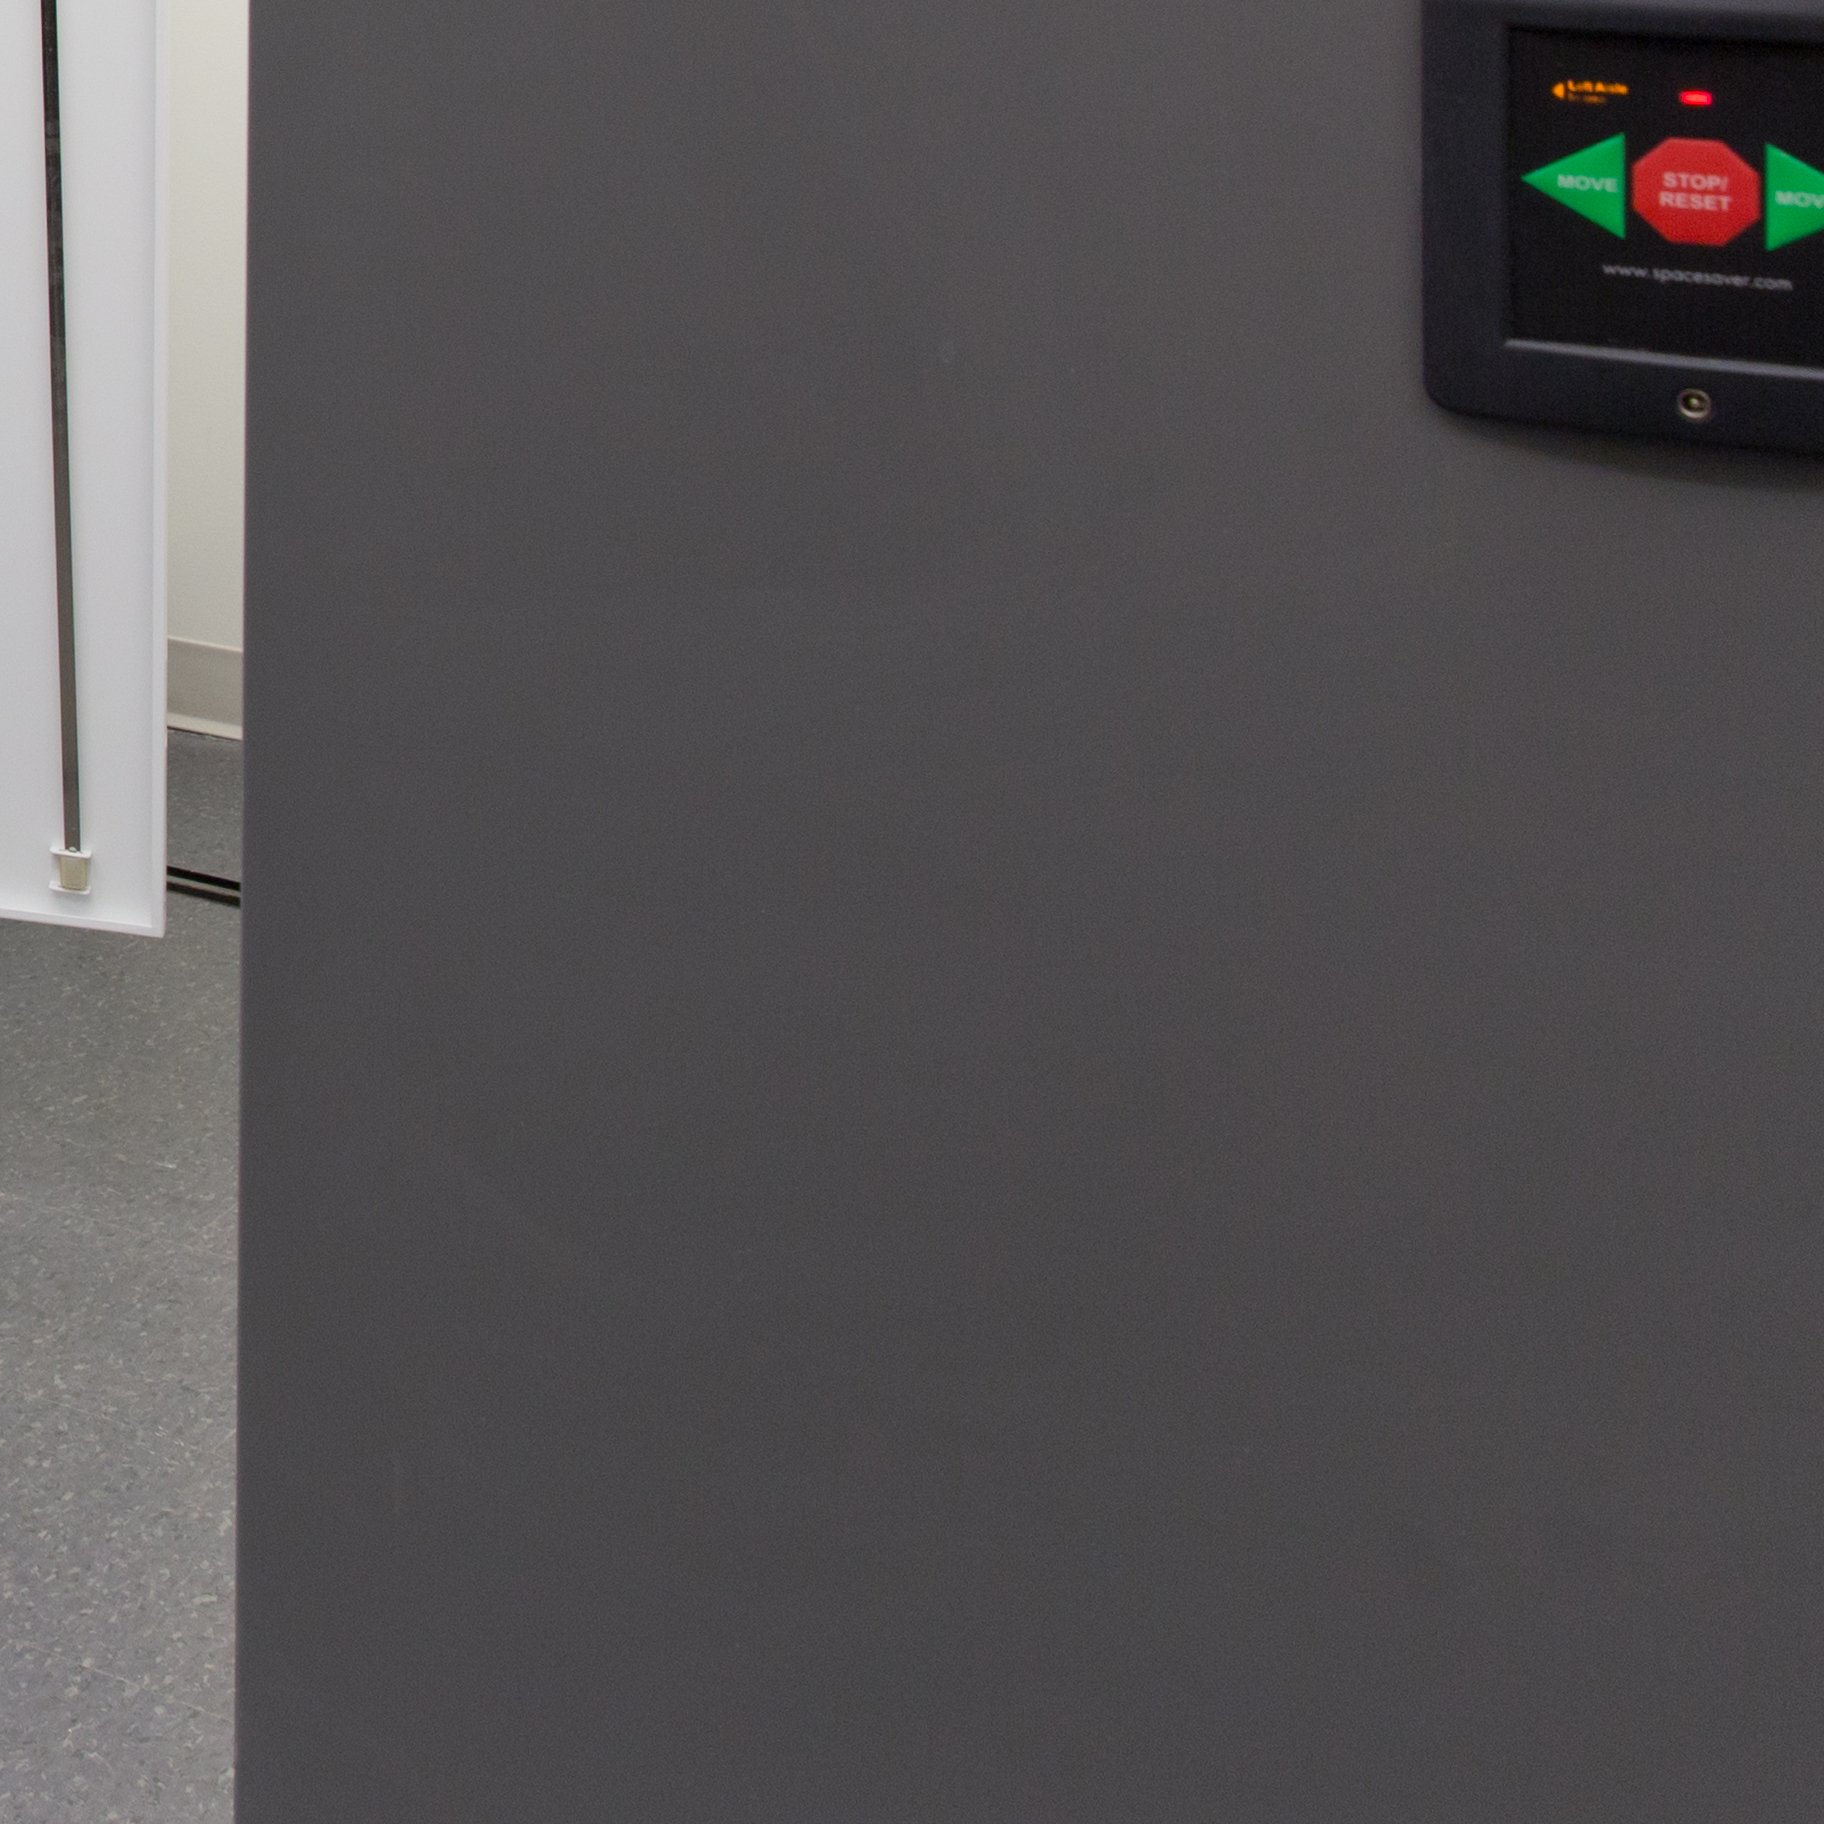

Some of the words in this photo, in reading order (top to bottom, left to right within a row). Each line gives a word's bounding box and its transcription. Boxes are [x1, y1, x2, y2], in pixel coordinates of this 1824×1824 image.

[1557, 174, 1618, 193] MOVE
[1658, 191, 1732, 211] RESET
[1775, 190, 1824, 209] MOV
